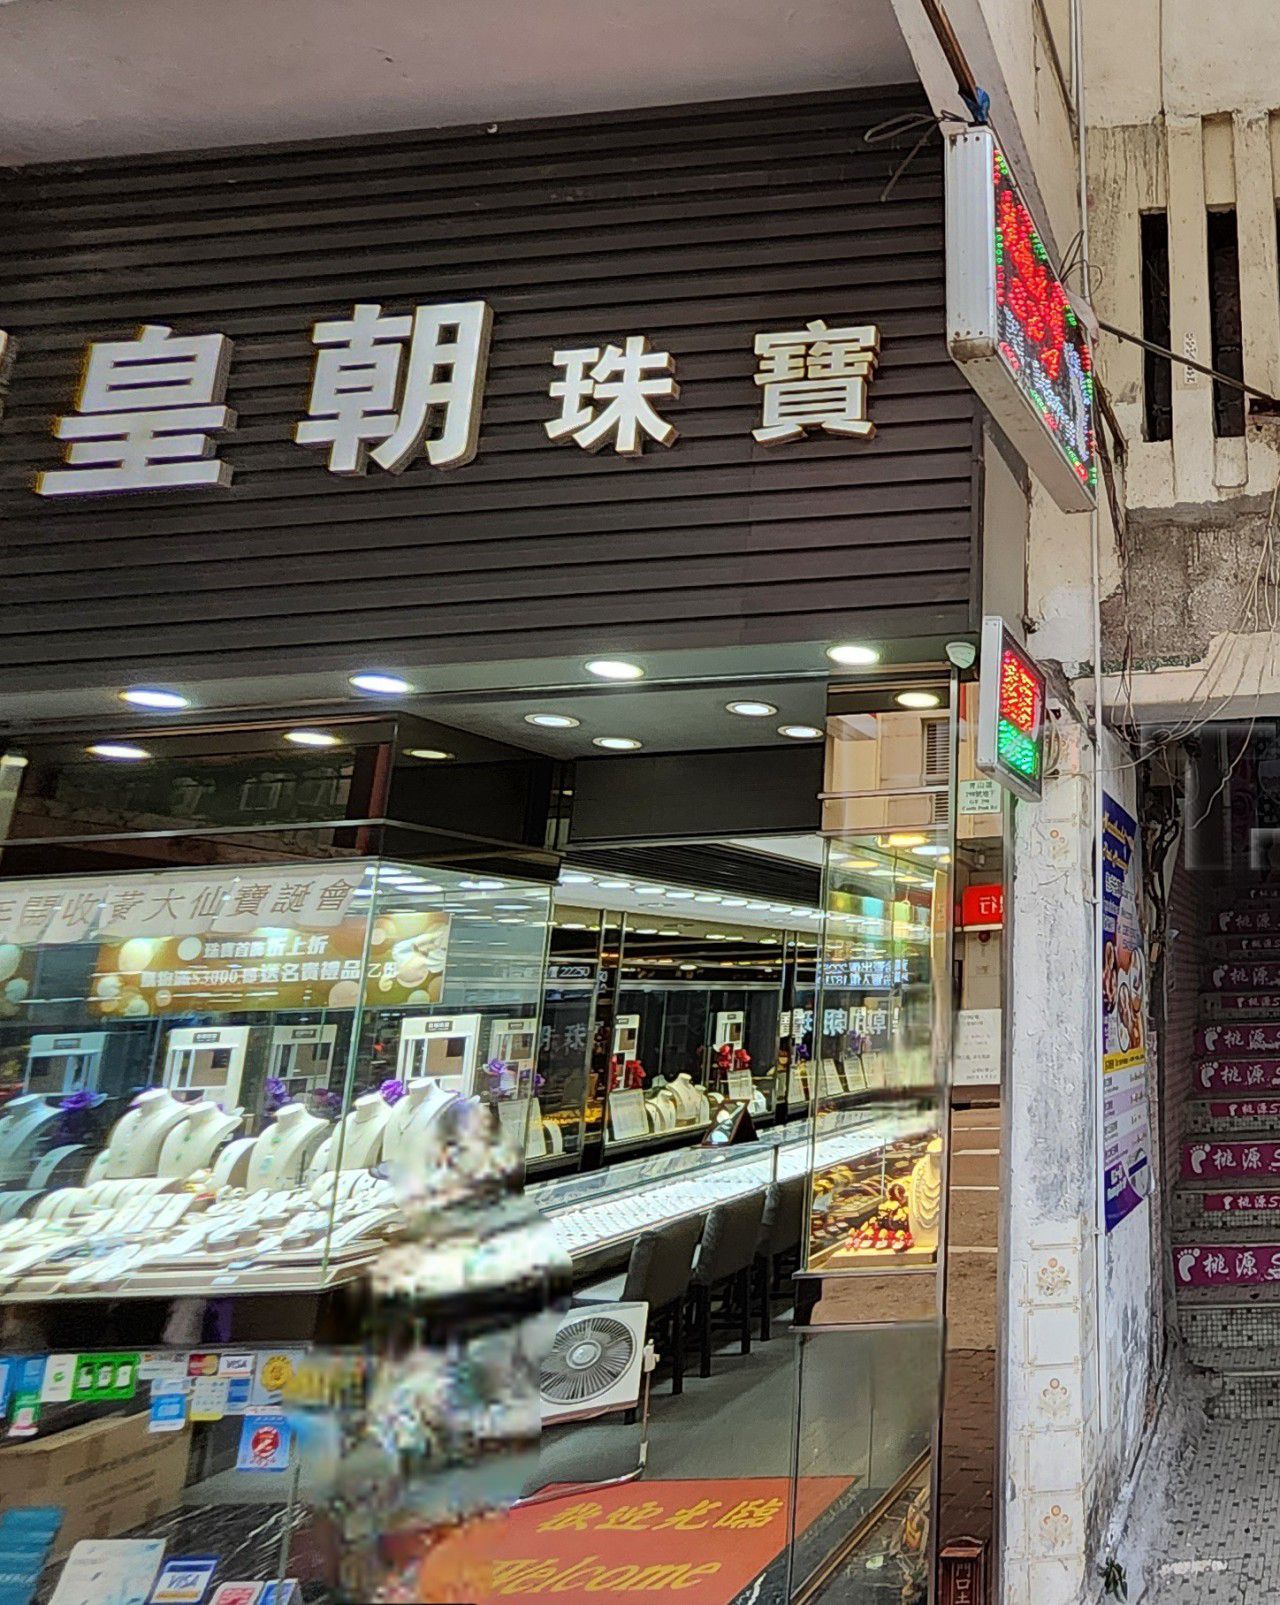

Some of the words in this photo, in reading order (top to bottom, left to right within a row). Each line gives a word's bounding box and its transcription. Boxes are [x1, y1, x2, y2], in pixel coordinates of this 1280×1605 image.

[36, 300, 882, 498] 皇朝珠寶
[1220, 1064, 1264, 1083] 桃源
[1212, 1148, 1262, 1170] 桃源
[1202, 1251, 1257, 1278] 桃源
